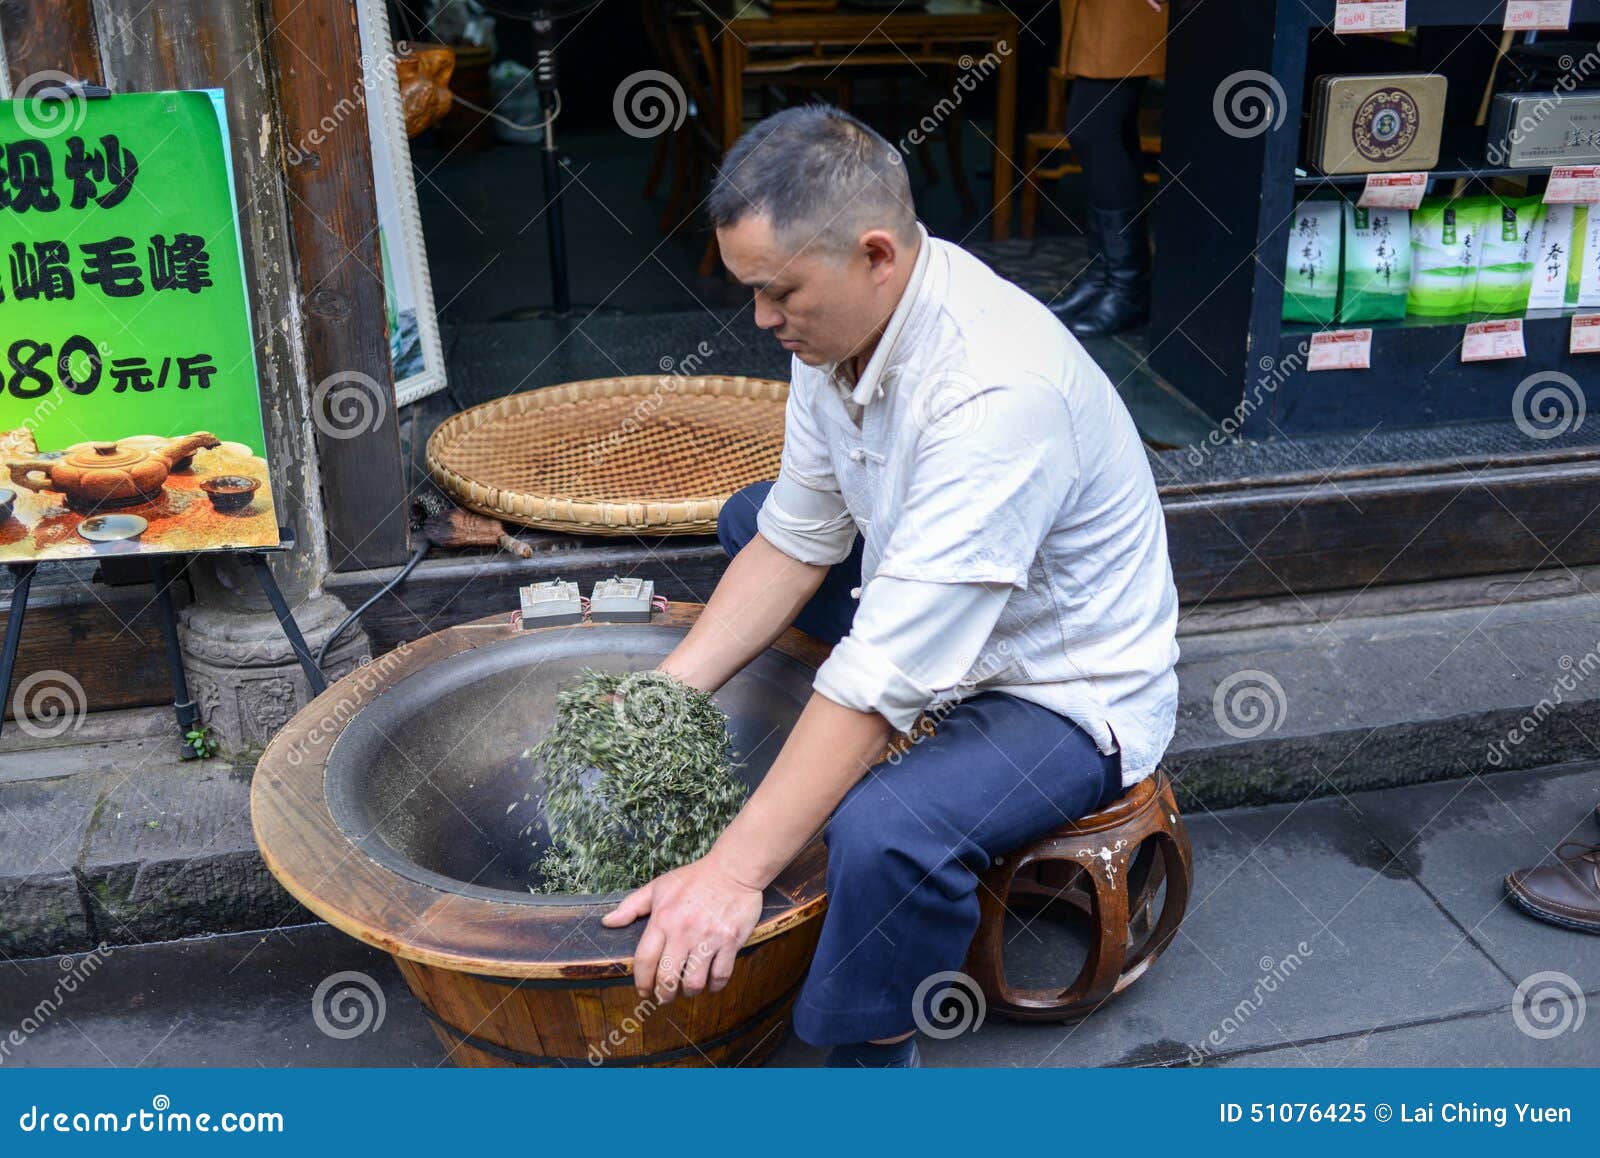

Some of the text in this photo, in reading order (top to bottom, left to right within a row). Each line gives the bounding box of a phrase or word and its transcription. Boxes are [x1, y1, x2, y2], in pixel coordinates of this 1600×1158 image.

[0, 134, 139, 214] 现炒
[0, 233, 213, 303] 嵋毛峰
[0, 335, 218, 399] 80元/斤
